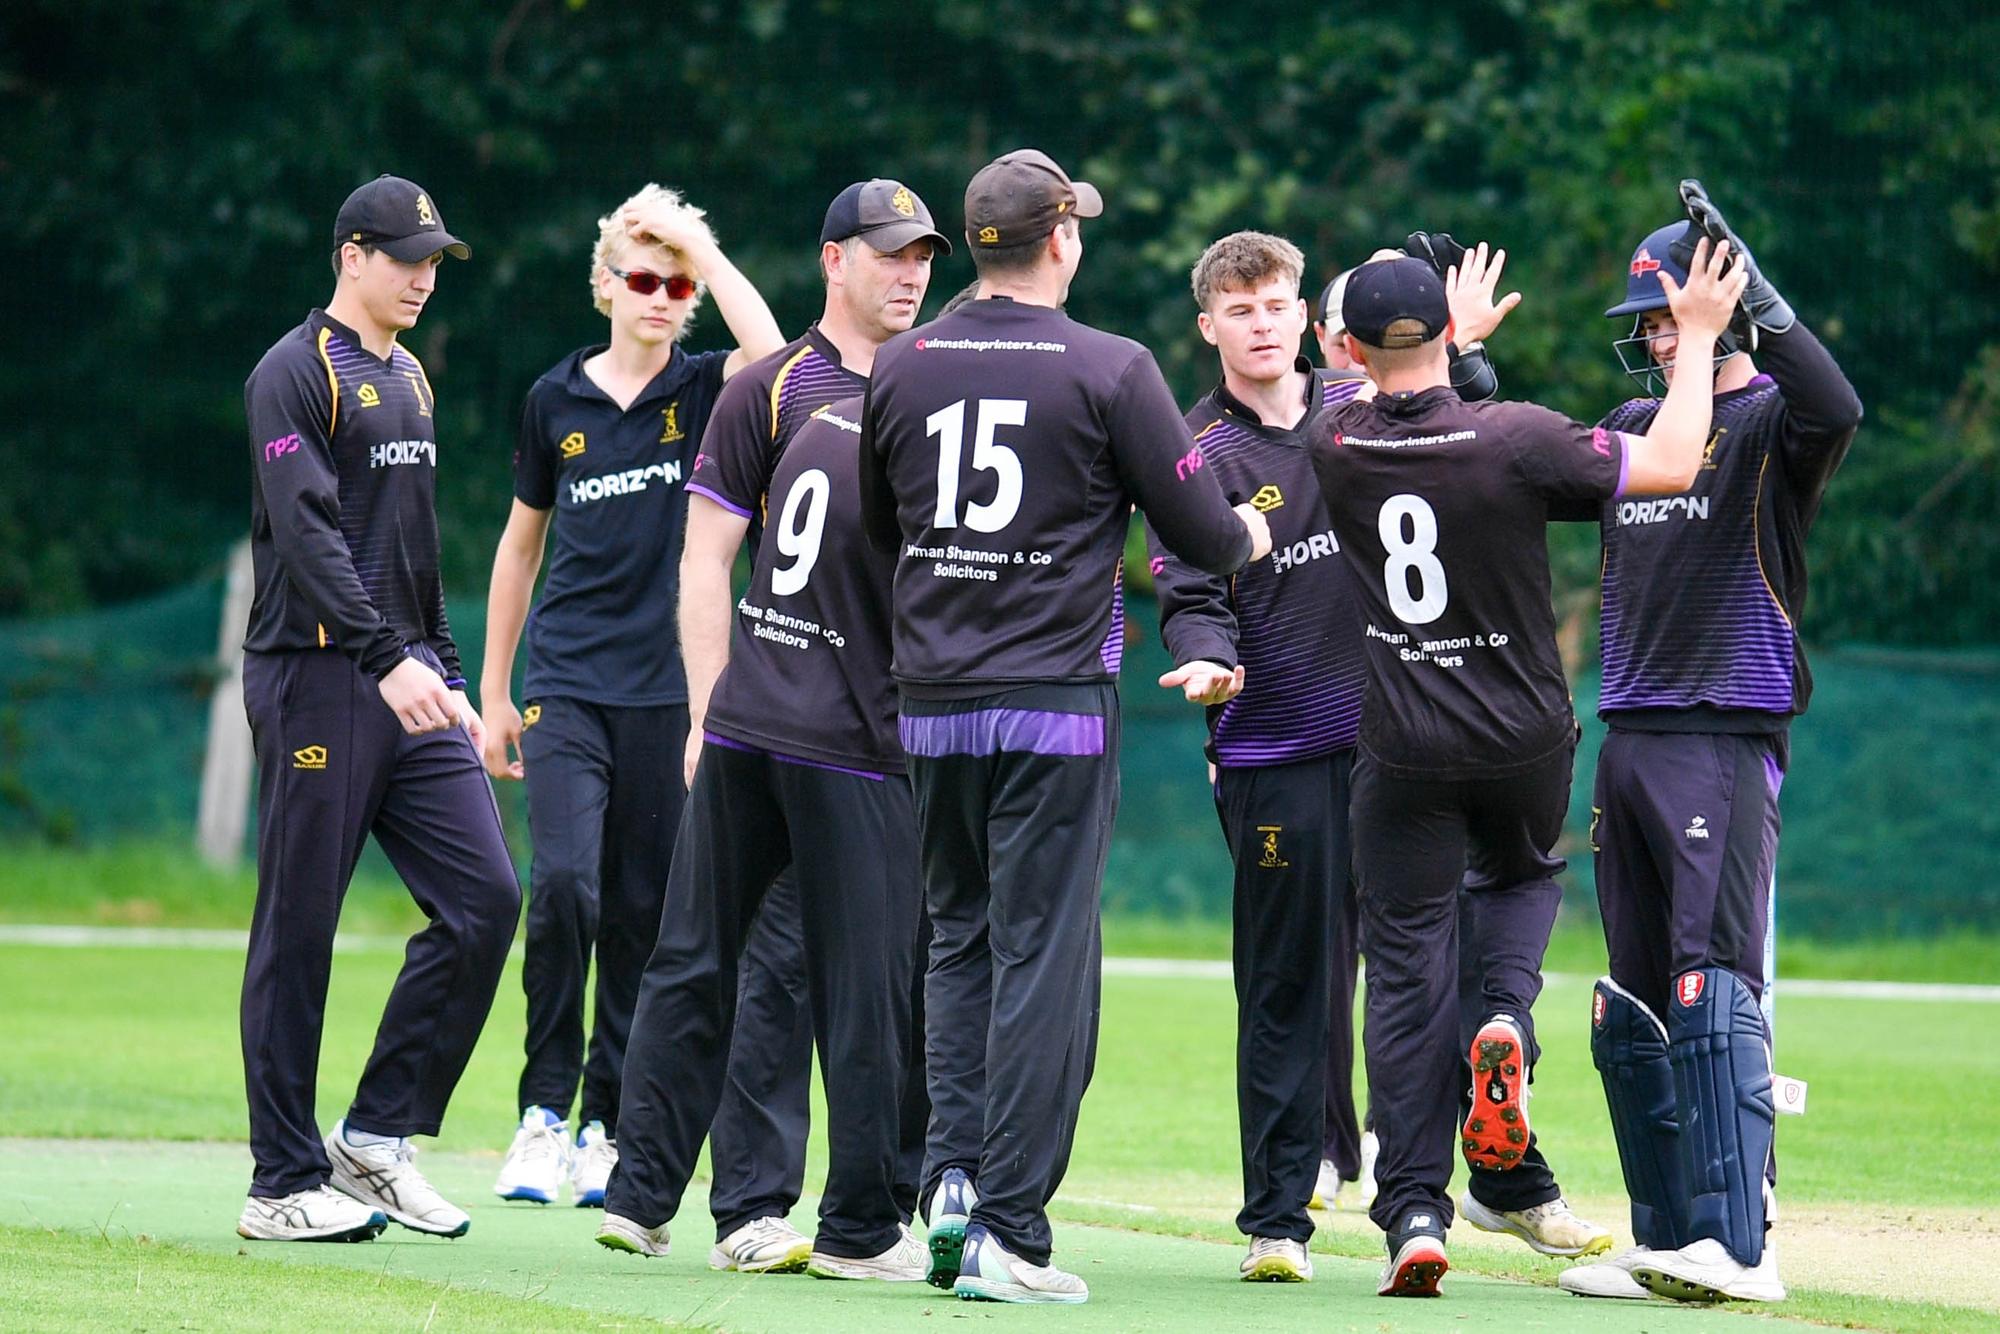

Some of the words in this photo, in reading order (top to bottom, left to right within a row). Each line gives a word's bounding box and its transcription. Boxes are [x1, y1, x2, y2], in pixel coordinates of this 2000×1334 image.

[925, 398, 1028, 533] 15
[569, 460, 682, 504] HORIZON
[771, 468, 830, 596] 9
[946, 546, 1008, 564] Shannon
[1013, 552, 1024, 564] &
[1029, 552, 1053, 565] Co
[1378, 493, 1449, 624] 8
[933, 563, 999, 582] Solicitors
[765, 607, 820, 634] Shannon
[753, 622, 810, 650] Solicitors
[1475, 635, 1485, 647] &
[1489, 633, 1509, 647] Co
